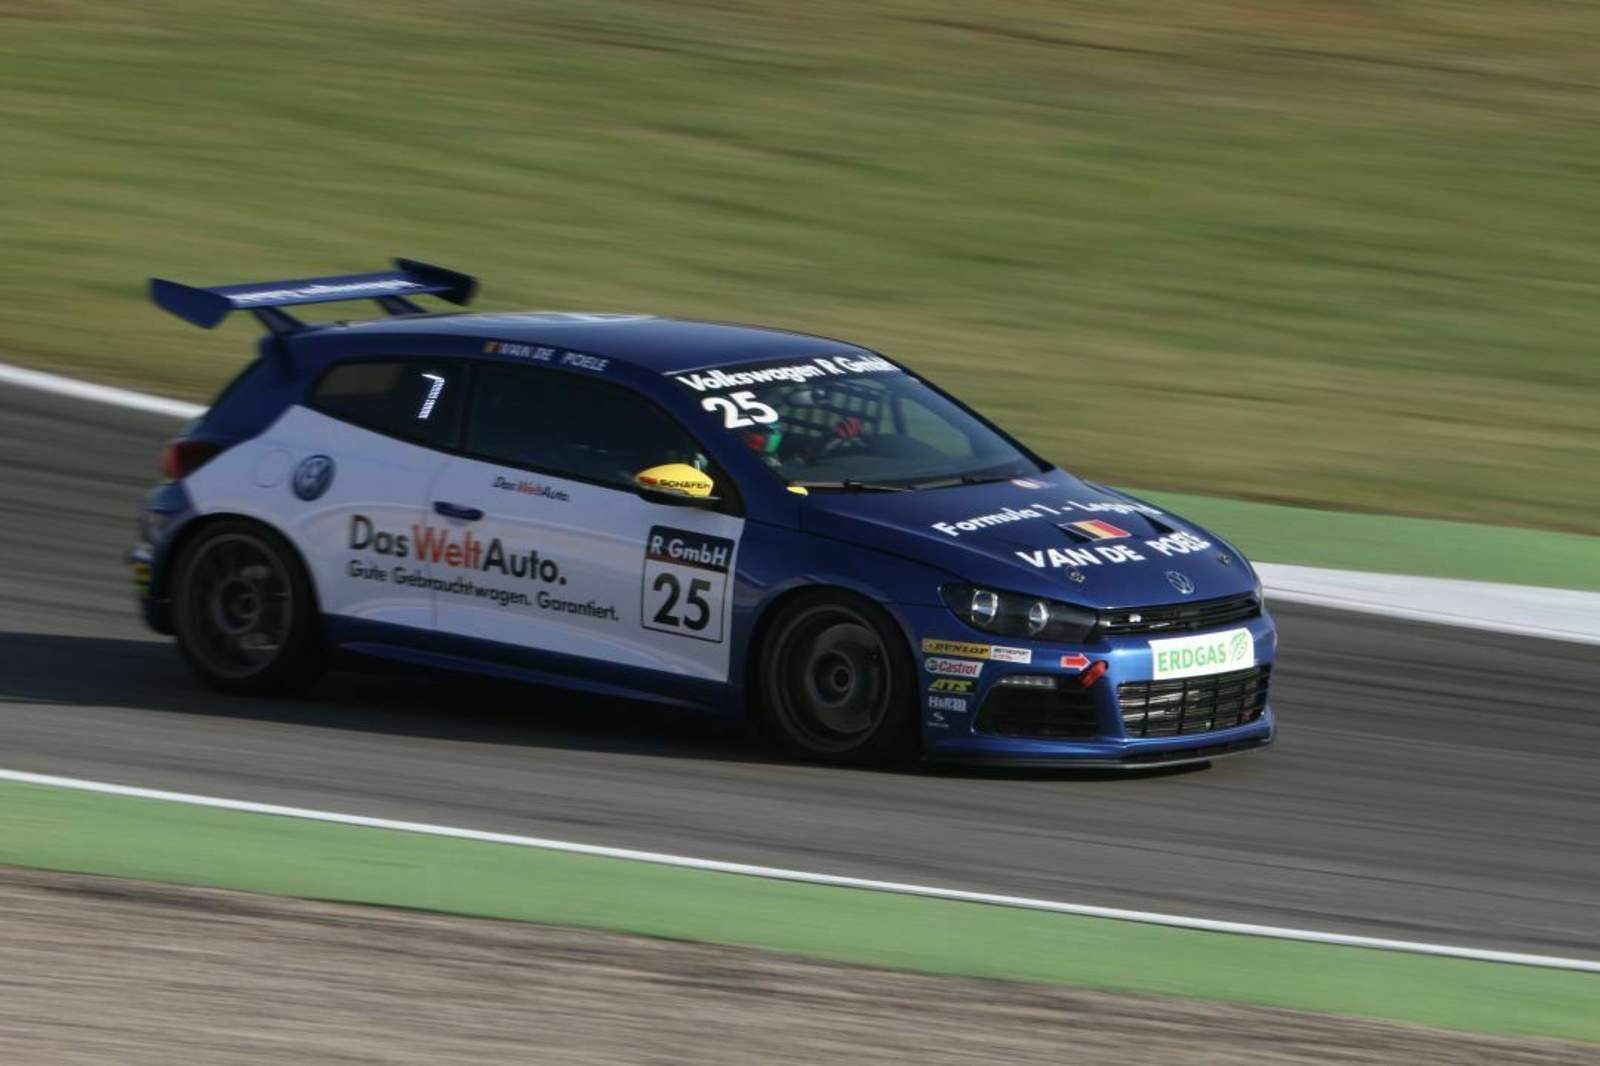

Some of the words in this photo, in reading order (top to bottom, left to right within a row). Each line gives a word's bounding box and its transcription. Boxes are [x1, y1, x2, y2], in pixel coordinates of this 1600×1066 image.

[676, 364, 826, 391] Volkswagen
[702, 391, 779, 429] 25
[932, 506, 1044, 537] Formula
[350, 514, 568, 586] DasWeltAuto.
[650, 535, 664, 555] R
[667, 538, 729, 566] GmbH
[1015, 547, 1103, 568] VAN
[1096, 545, 1146, 564] DE
[653, 572, 711, 632] 25
[937, 661, 978, 676] Castrol
[1157, 643, 1226, 673] ERDGAS
